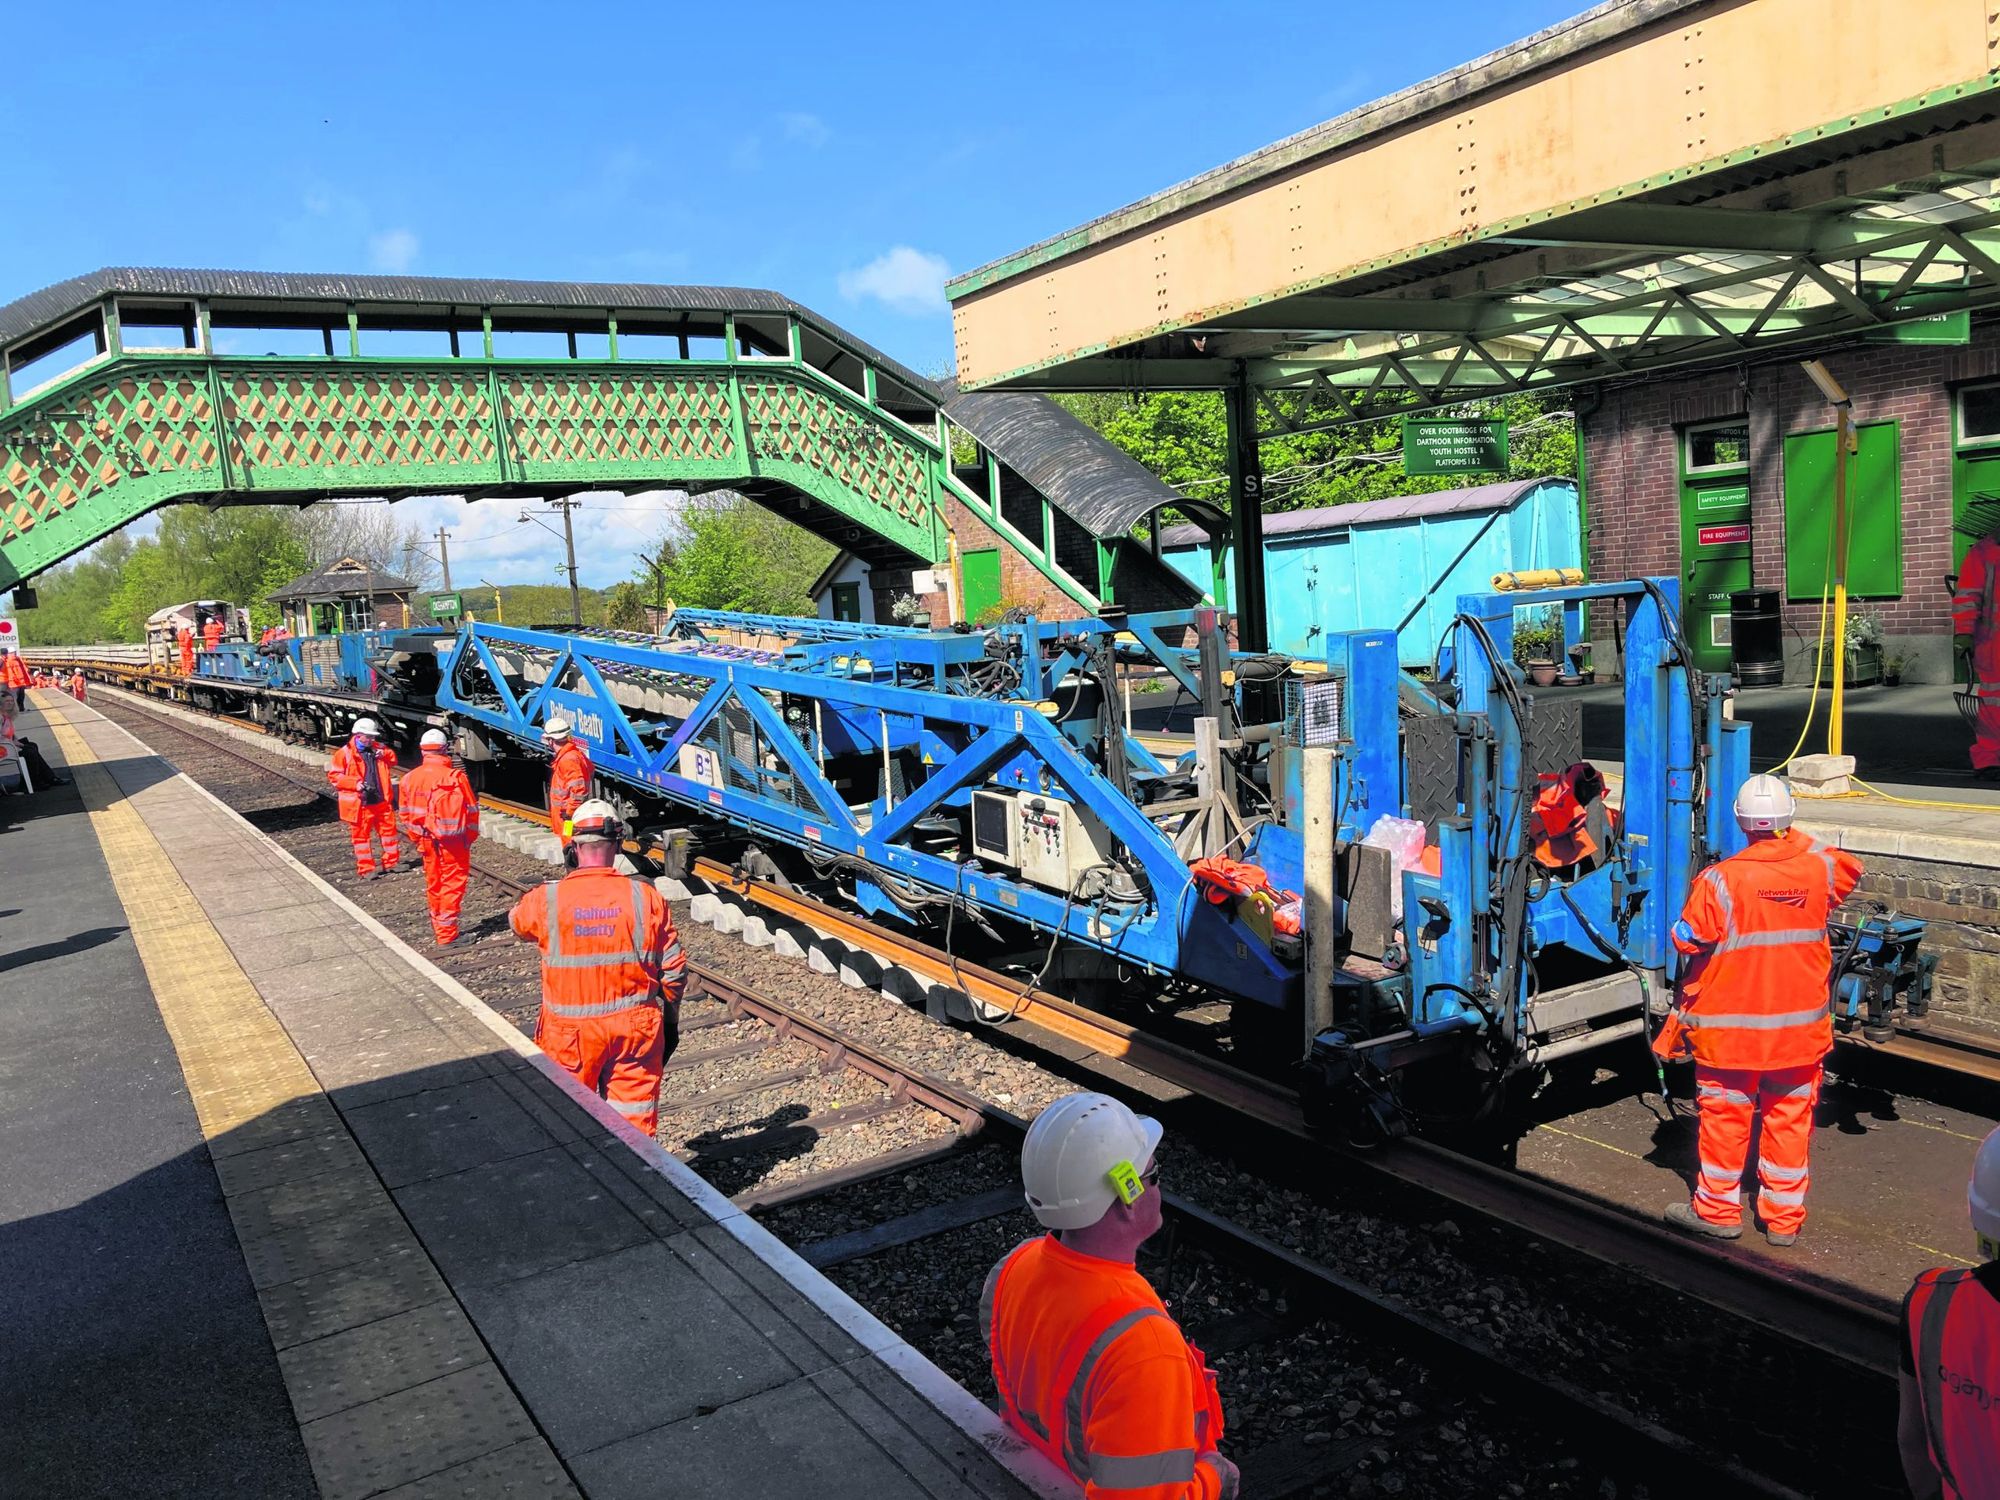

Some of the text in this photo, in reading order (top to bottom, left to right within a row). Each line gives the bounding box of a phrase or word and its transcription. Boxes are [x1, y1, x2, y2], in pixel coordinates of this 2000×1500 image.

[1420, 427, 1436, 435] OVER
[1438, 427, 1477, 435] FOOTBRIDGE
[1417, 438, 1451, 446] DARTMOOR
[1430, 448, 1451, 456] YOUTH
[1454, 447, 1478, 455] HOSTEL
[1436, 458, 1467, 466] PLATFORMS
[1245, 475, 1257, 491] S
[1719, 493, 1746, 502] EQUIPMENT
[1715, 530, 1746, 539] EQUIPMENT
[577, 708, 602, 743] Beatty
[574, 907, 621, 920] Balfour
[574, 924, 616, 938] Beatty
